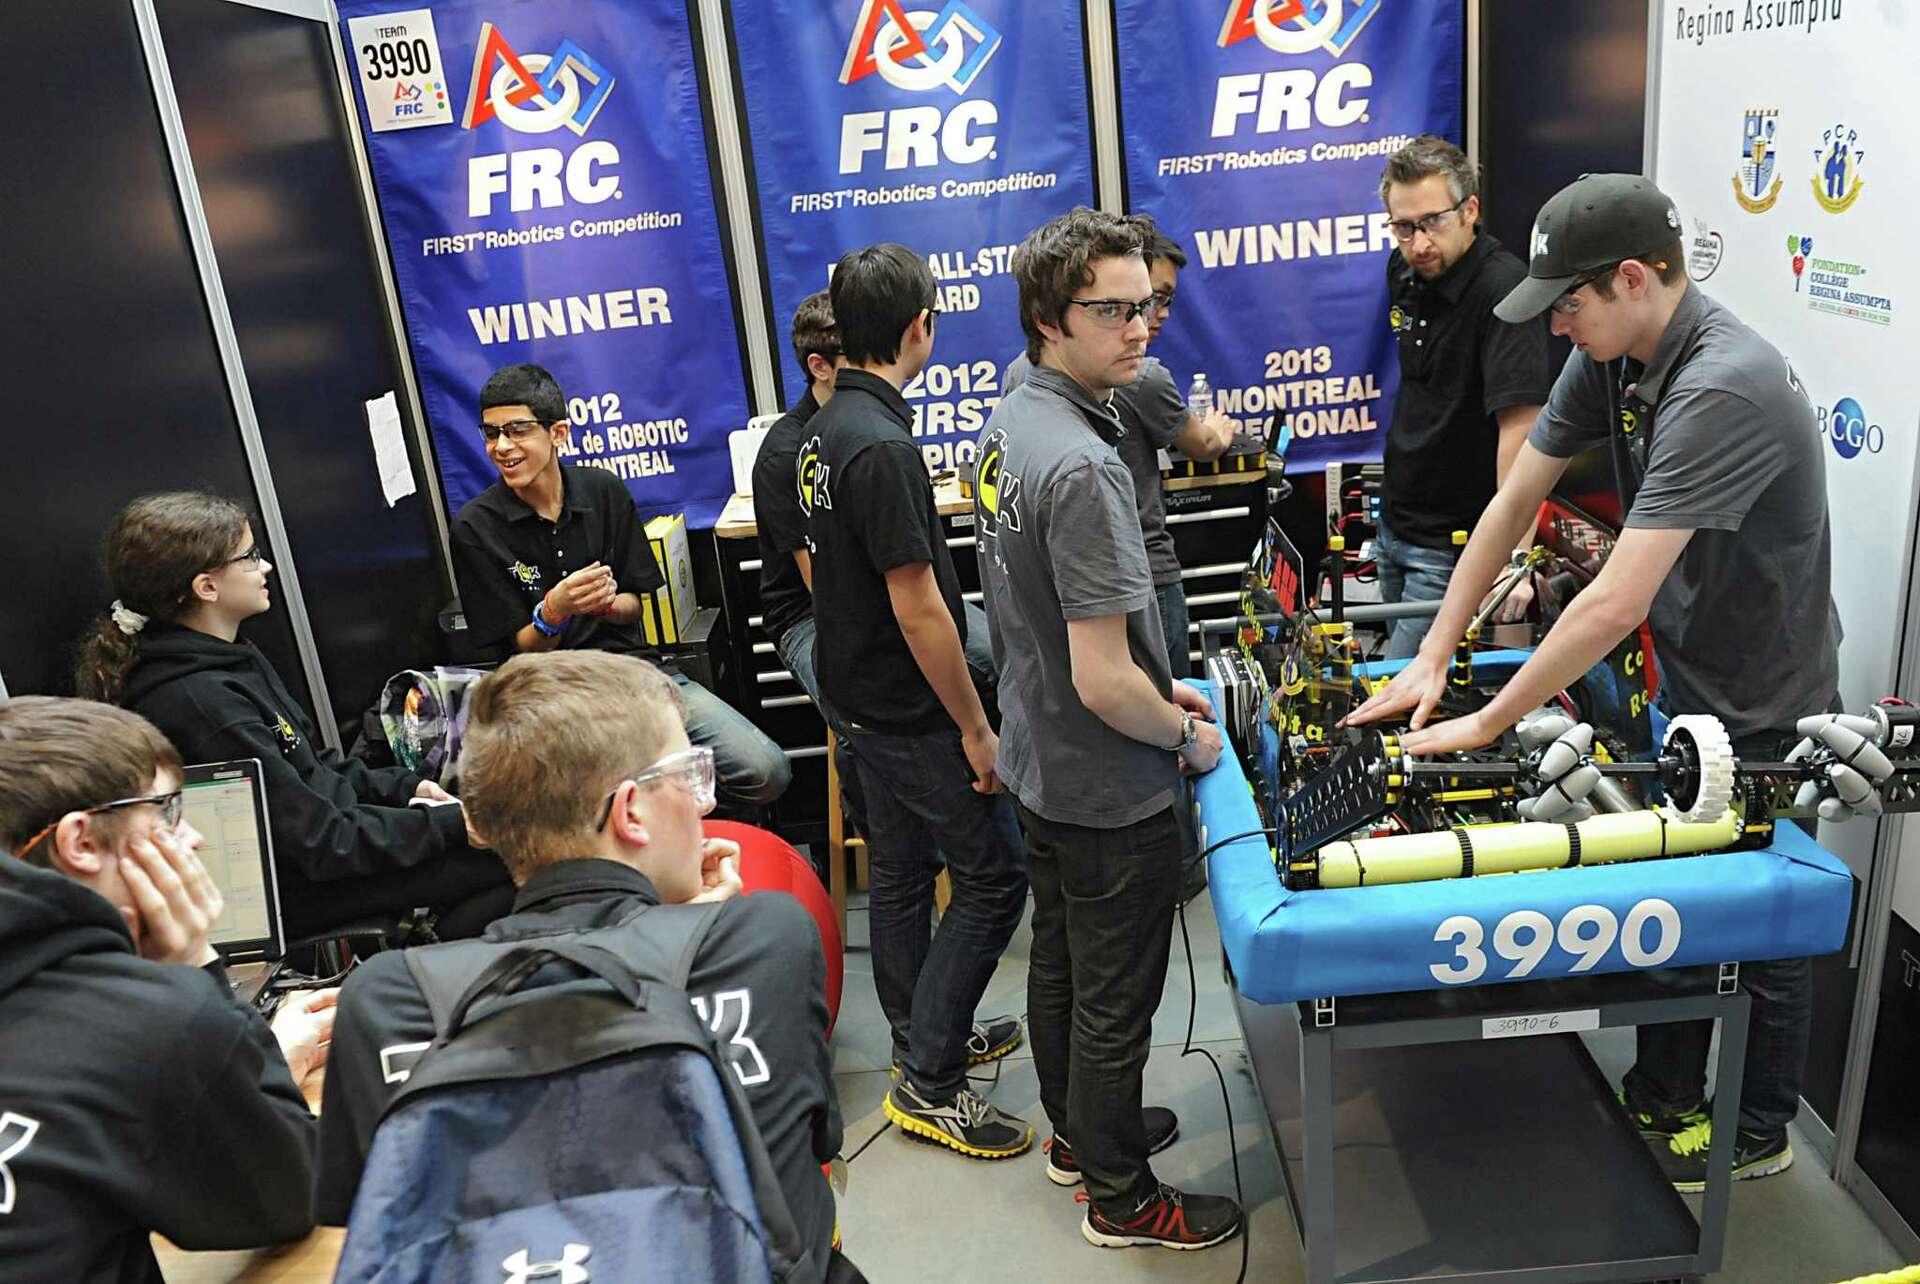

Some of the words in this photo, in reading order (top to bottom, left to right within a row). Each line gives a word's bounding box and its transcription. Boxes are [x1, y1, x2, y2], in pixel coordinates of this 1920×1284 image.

[378, 26, 407, 38] TEAM
[1676, 4, 1734, 45] Regina
[362, 38, 432, 81] 3990
[394, 102, 423, 116] FRC
[1223, 148, 1306, 171] Robotics
[852, 184, 937, 207] Robotics
[941, 172, 1056, 199] Competition
[485, 226, 565, 249] Robotics
[569, 211, 682, 239] Competition
[1194, 212, 1400, 269] WINNER
[467, 287, 673, 345] WINNER
[934, 284, 981, 313] ARD
[1264, 346, 1332, 379] 2013
[566, 393, 622, 426] 012
[1217, 374, 1382, 414] MONTREAL
[582, 430, 604, 455] de
[607, 418, 689, 451] ROBOTIC
[1429, 898, 1682, 984] 3990
